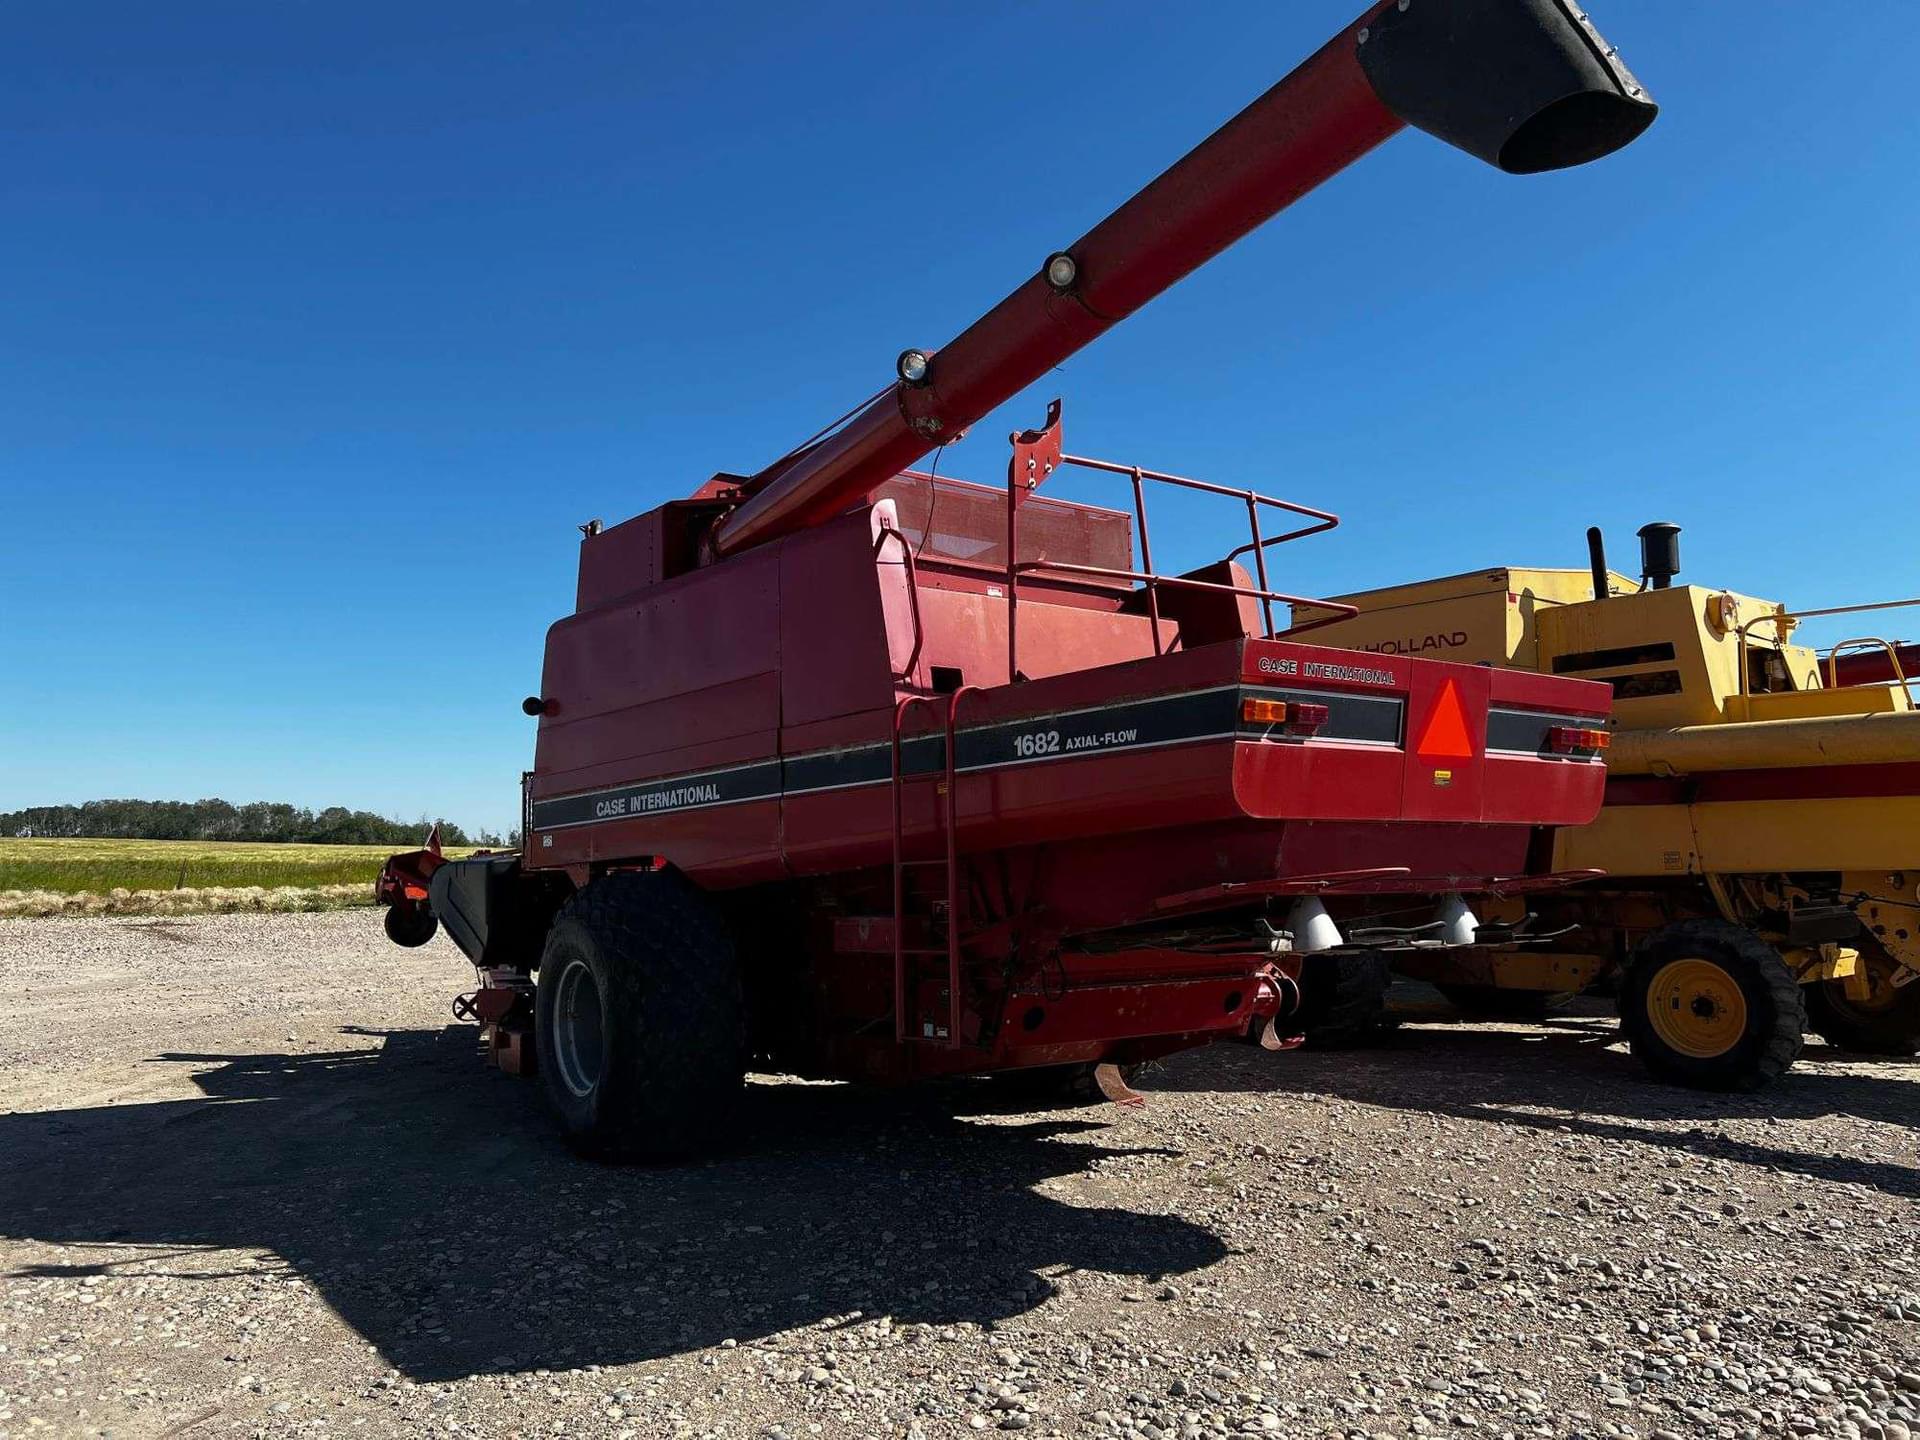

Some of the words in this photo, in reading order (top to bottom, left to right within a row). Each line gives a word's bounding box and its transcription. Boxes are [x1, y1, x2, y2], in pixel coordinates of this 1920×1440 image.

[1258, 657, 1297, 675] CASE
[1303, 662, 1396, 686] INTERNATIONAL
[1013, 730, 1060, 757] 1682
[1065, 729, 1137, 750] AXIAL-FLOW
[596, 798, 626, 817] CASE
[630, 784, 720, 812] INTERNATIONAL
